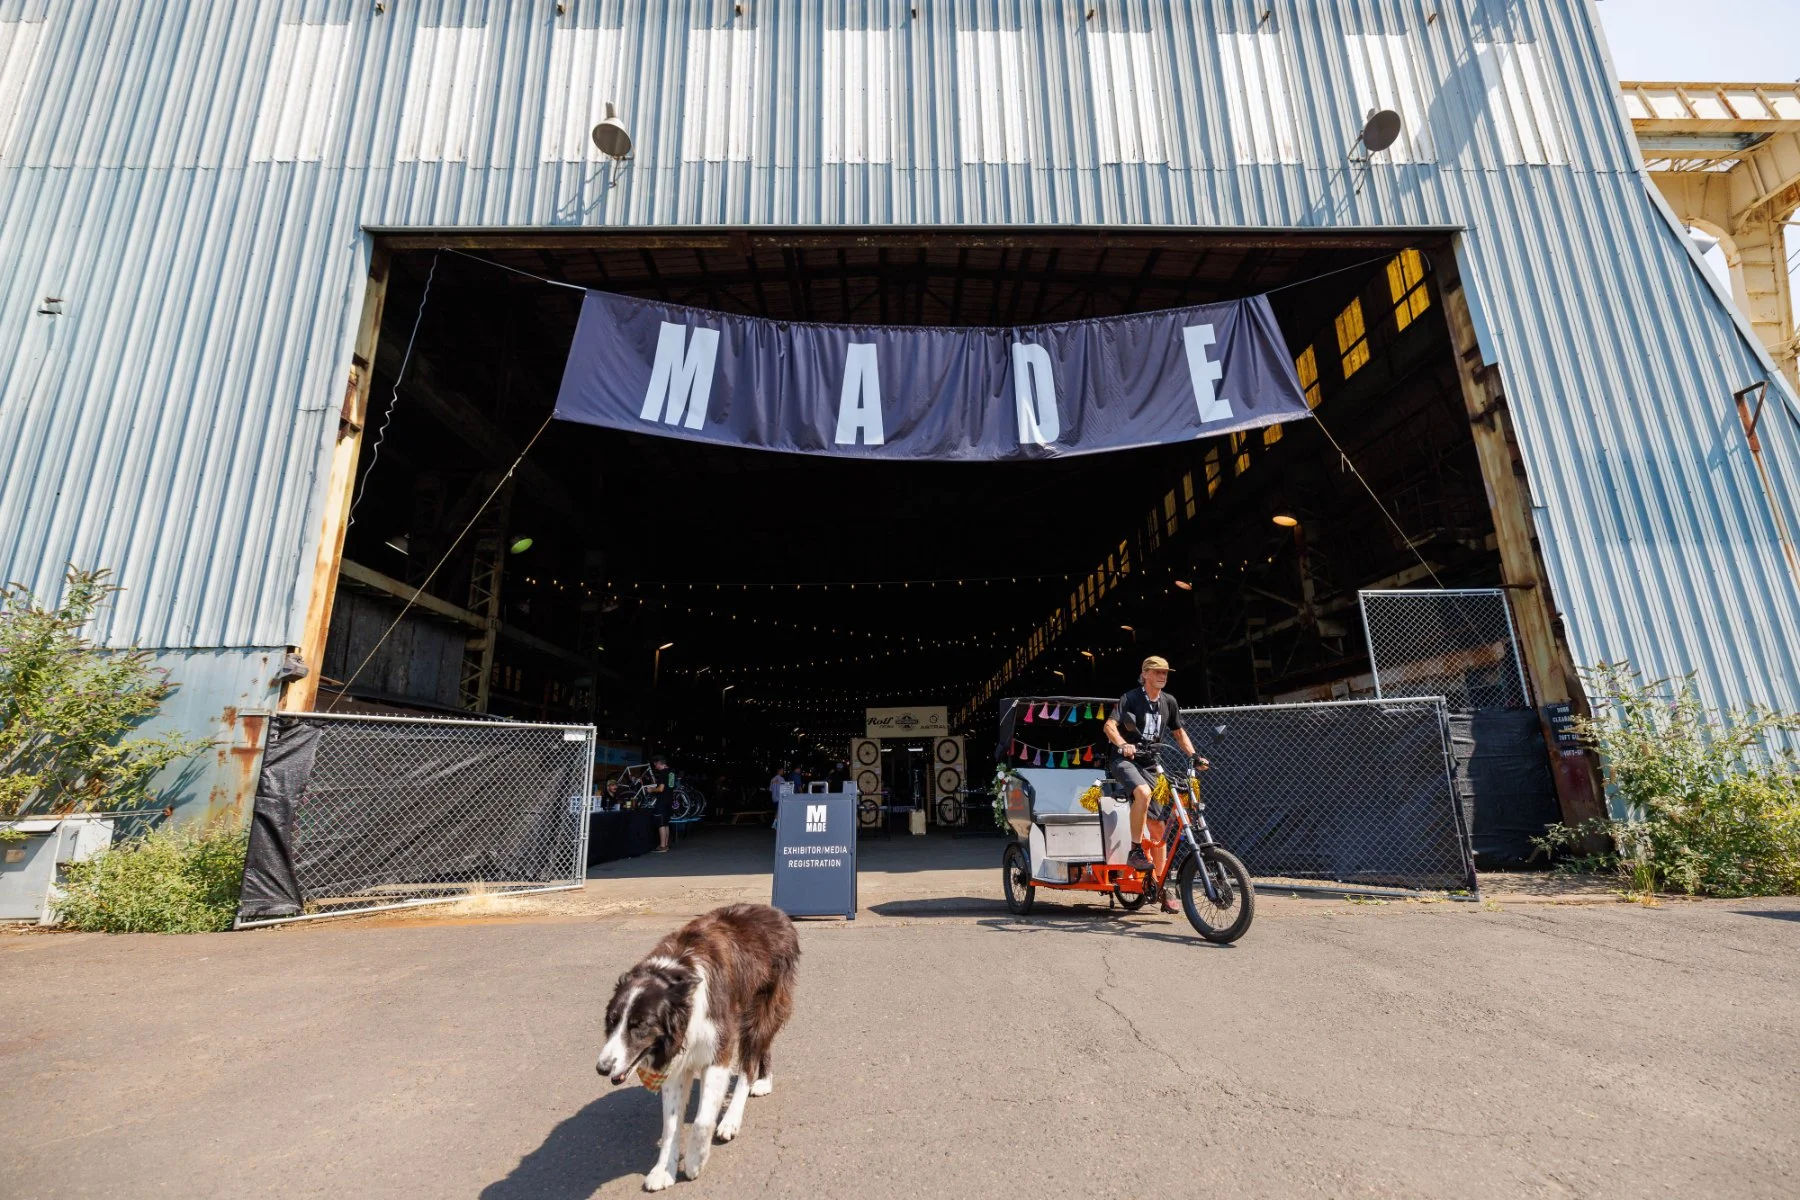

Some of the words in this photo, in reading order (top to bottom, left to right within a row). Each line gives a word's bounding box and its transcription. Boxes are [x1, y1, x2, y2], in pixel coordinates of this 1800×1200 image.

[640, 321, 1234, 446] MADE
[867, 717, 894, 725] Rolf
[806, 805, 827, 822] M
[806, 823, 827, 832] MADE
[783, 846, 848, 855] EXHIBITOR/MEDIA
[788, 859, 842, 868] REGISTRATION
